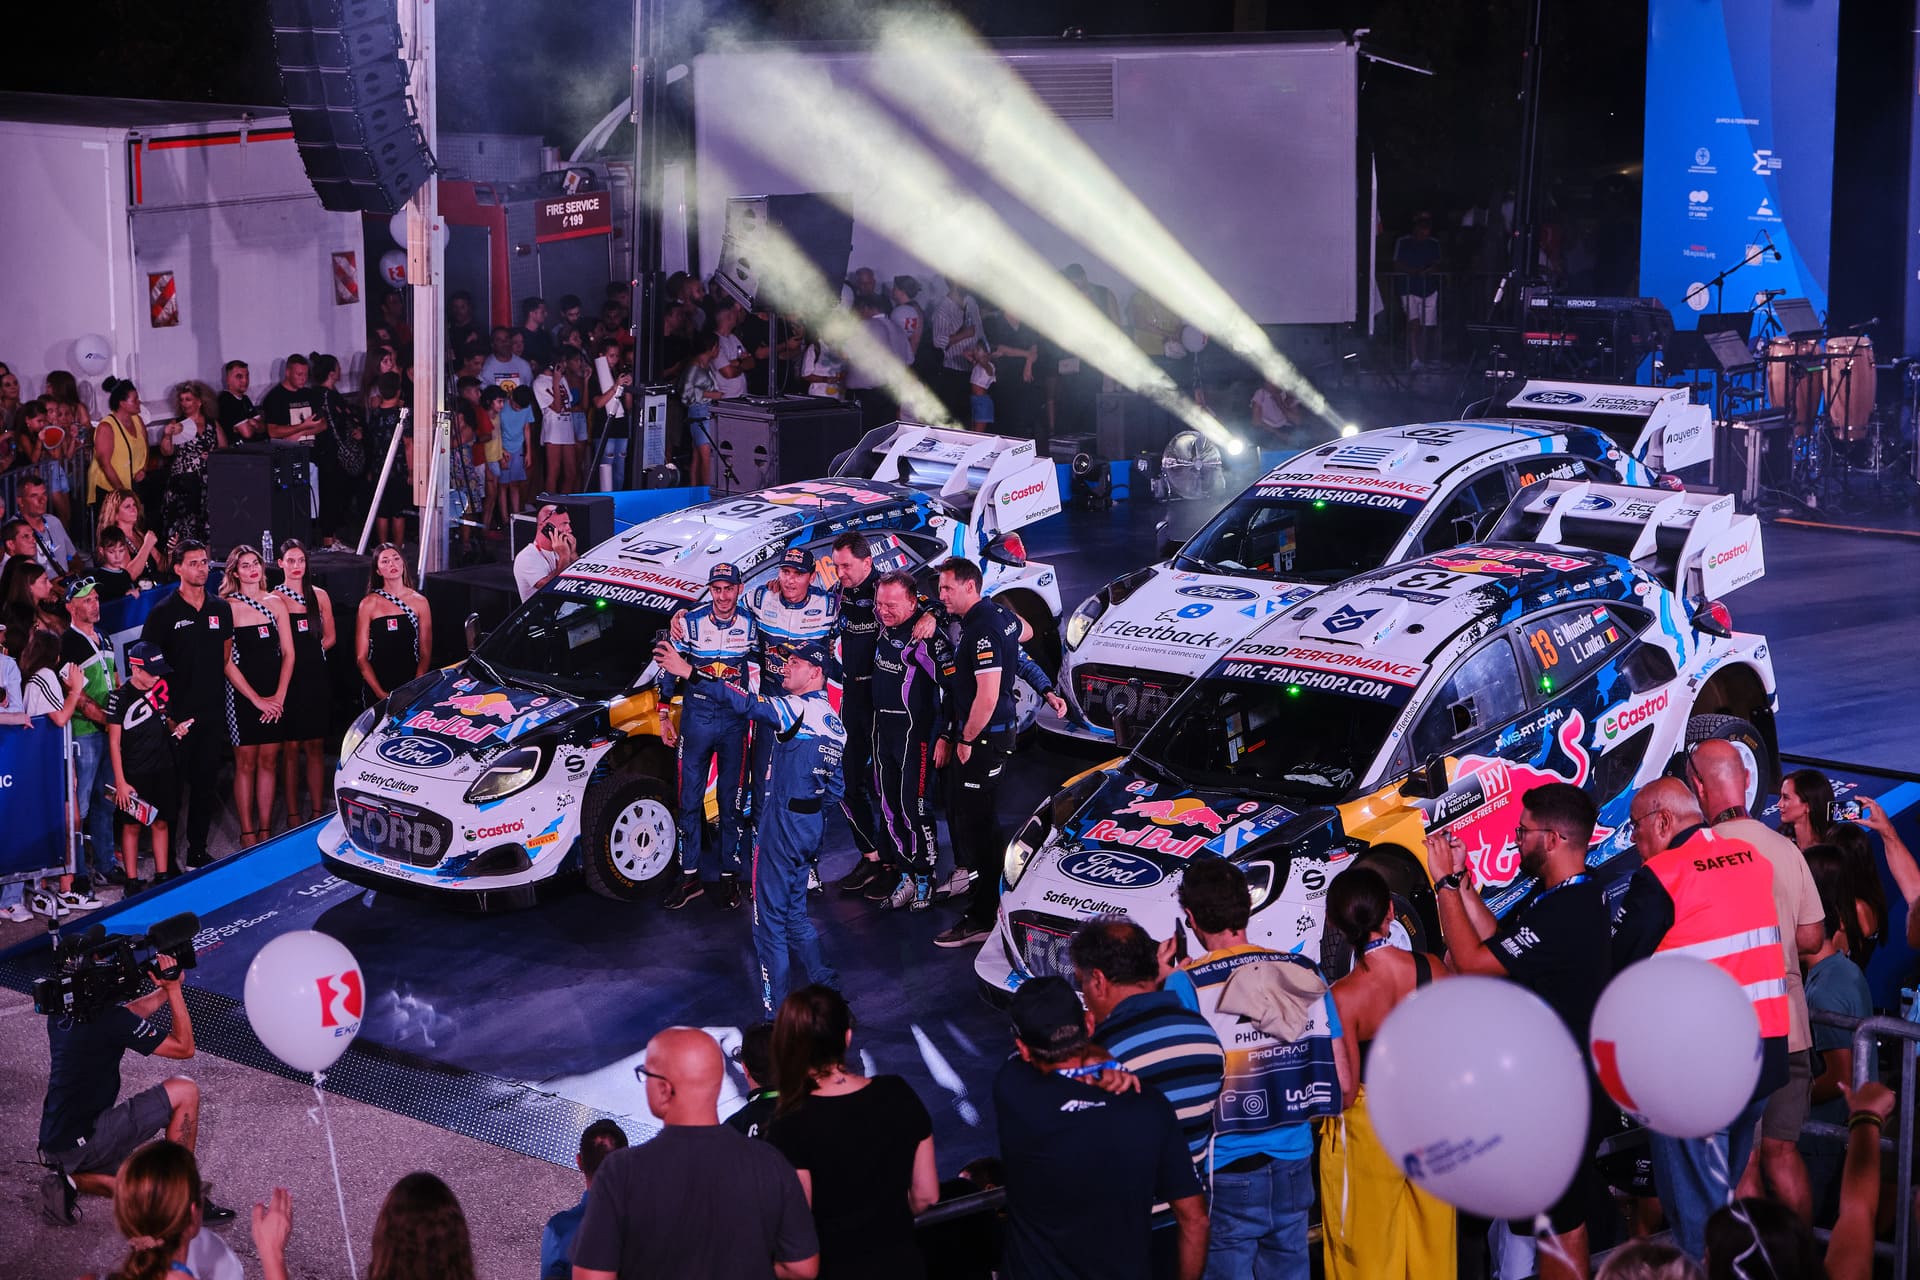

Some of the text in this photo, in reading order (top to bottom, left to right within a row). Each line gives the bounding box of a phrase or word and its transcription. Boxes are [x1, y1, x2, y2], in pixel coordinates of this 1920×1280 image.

[546, 198, 599, 216] FIRE SERVICE
[570, 213, 583, 226] 199
[1567, 300, 1596, 308] KRONOS
[1532, 392, 1577, 405] Ford
[1011, 443, 1033, 456] sparco
[1010, 481, 1044, 501] Castrol
[1255, 487, 1408, 509] WRC-FANSHOP.COM
[1025, 504, 1060, 521] SafetyCulture
[1717, 542, 1748, 564] Castrol
[1397, 572, 1467, 590] 13
[1731, 567, 1763, 586] SafetyCulture
[554, 579, 678, 611] WRC-FANSHOP.COM
[1188, 584, 1242, 600] Ford
[847, 621, 878, 631] Fleetback
[1105, 620, 1220, 648] Fleetback
[1102, 641, 1123, 649] dealers
[1131, 644, 1166, 655] customers
[1168, 648, 1206, 660] connected
[1530, 614, 1595, 669] 13 G Munster
[1570, 634, 1605, 664] L Louka
[1223, 662, 1393, 700] WRC-FANSHOP.COM
[547, 711, 560, 720] 16
[1396, 699, 1419, 733] Fleetback
[1617, 689, 1669, 731] Castrol
[830, 716, 843, 734] Ford
[1502, 708, 1564, 747] MS-RT.COM
[384, 738, 443, 765] Ford
[358, 771, 419, 793] SafetyCulture
[918, 742, 928, 816] FORD PERFORMANCE
[1481, 770, 1505, 797] HY
[1261, 819, 1280, 830] 13
[1453, 797, 1510, 832] FOSSIL-FREE FUEL
[346, 806, 441, 856] FORD
[529, 834, 557, 847] PIRELLI
[1070, 853, 1148, 884] Ford
[1694, 851, 1753, 872] SAFETY
[1042, 888, 1128, 915] SafetyCulture
[242, 910, 278, 929] GODS
[1193, 965, 1212, 976] WRC
[1213, 961, 1228, 970] EKO
[1229, 955, 1267, 967] ACROPOLIS
[761, 964, 772, 1004] MS-RT
[334, 1022, 359, 1037] EKO
[1286, 1082, 1332, 1102] WRC
